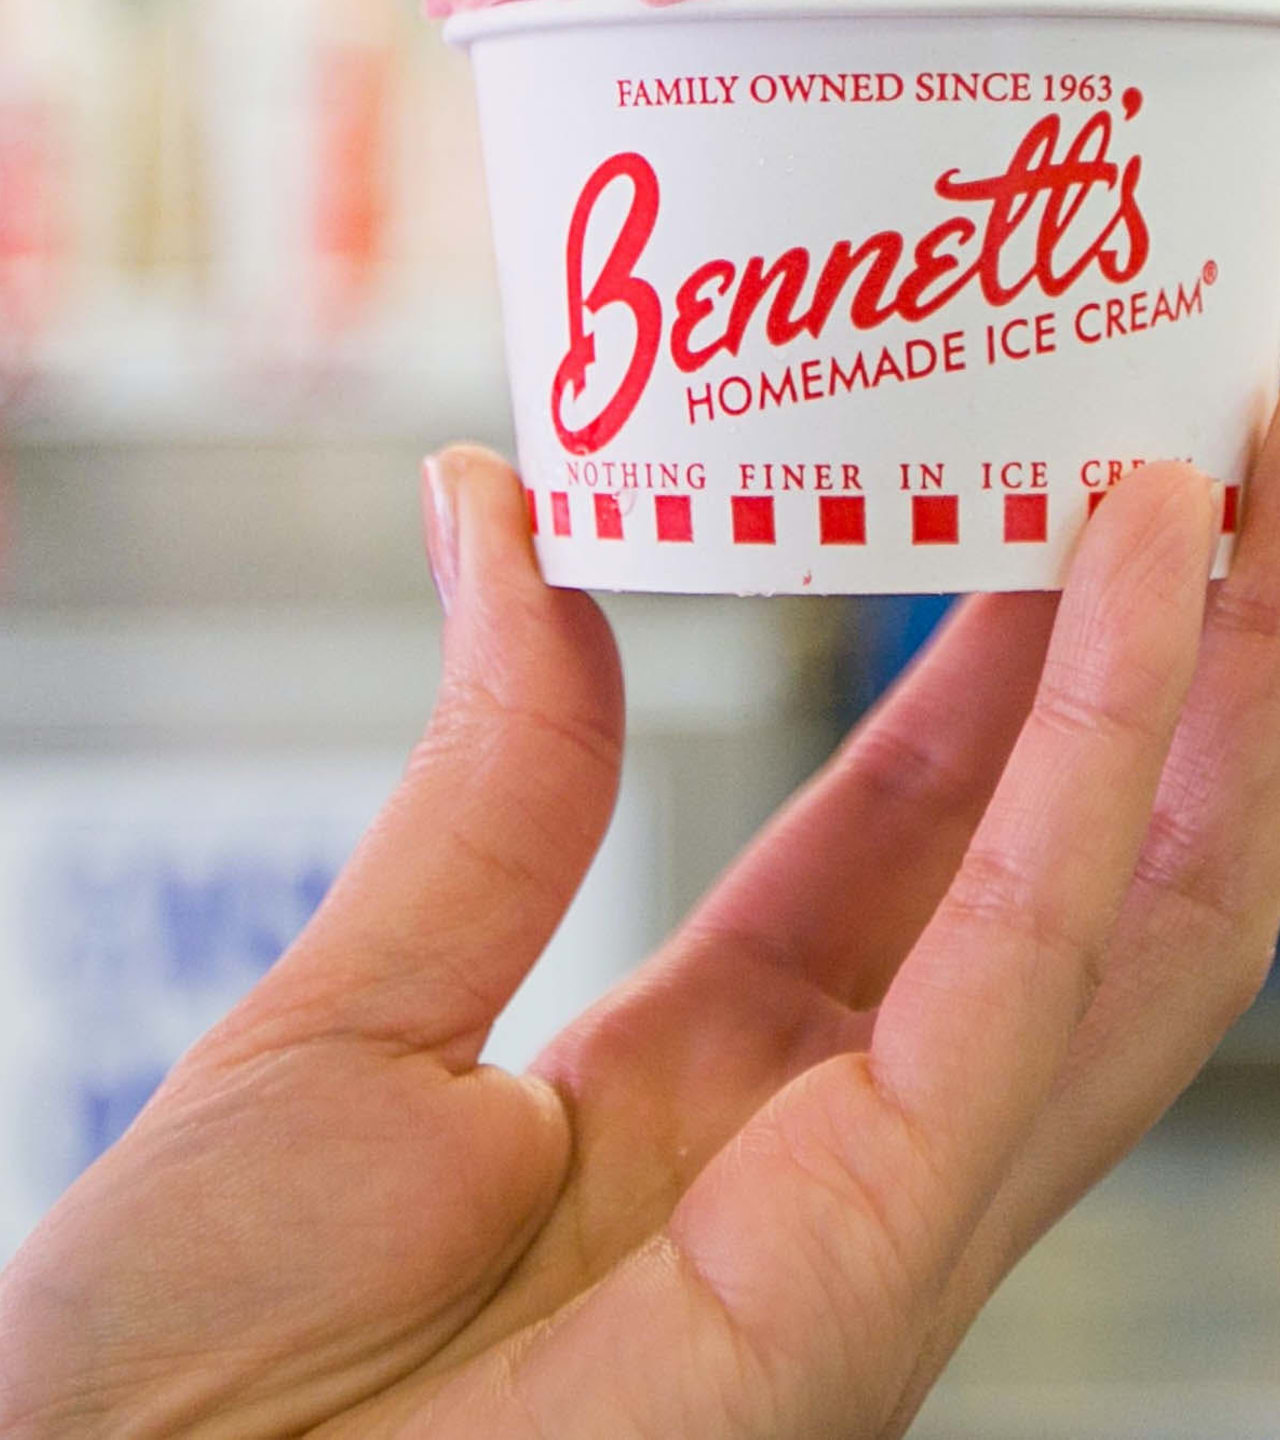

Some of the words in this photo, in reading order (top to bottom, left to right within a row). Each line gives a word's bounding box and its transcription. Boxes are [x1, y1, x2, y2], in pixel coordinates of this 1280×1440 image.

[616, 75, 739, 108] FAMILY
[748, 72, 906, 106] OWNED
[915, 71, 1031, 104] SINCE
[1042, 73, 1114, 104] 1963
[549, 86, 1150, 457] Bennett's
[685, 329, 967, 426] HOMEMADE
[985, 311, 1057, 366] ICE
[566, 461, 708, 491] NOTHING
[738, 462, 863, 493] FINER
[900, 461, 946, 492] IN
[981, 461, 1048, 491] ICE
